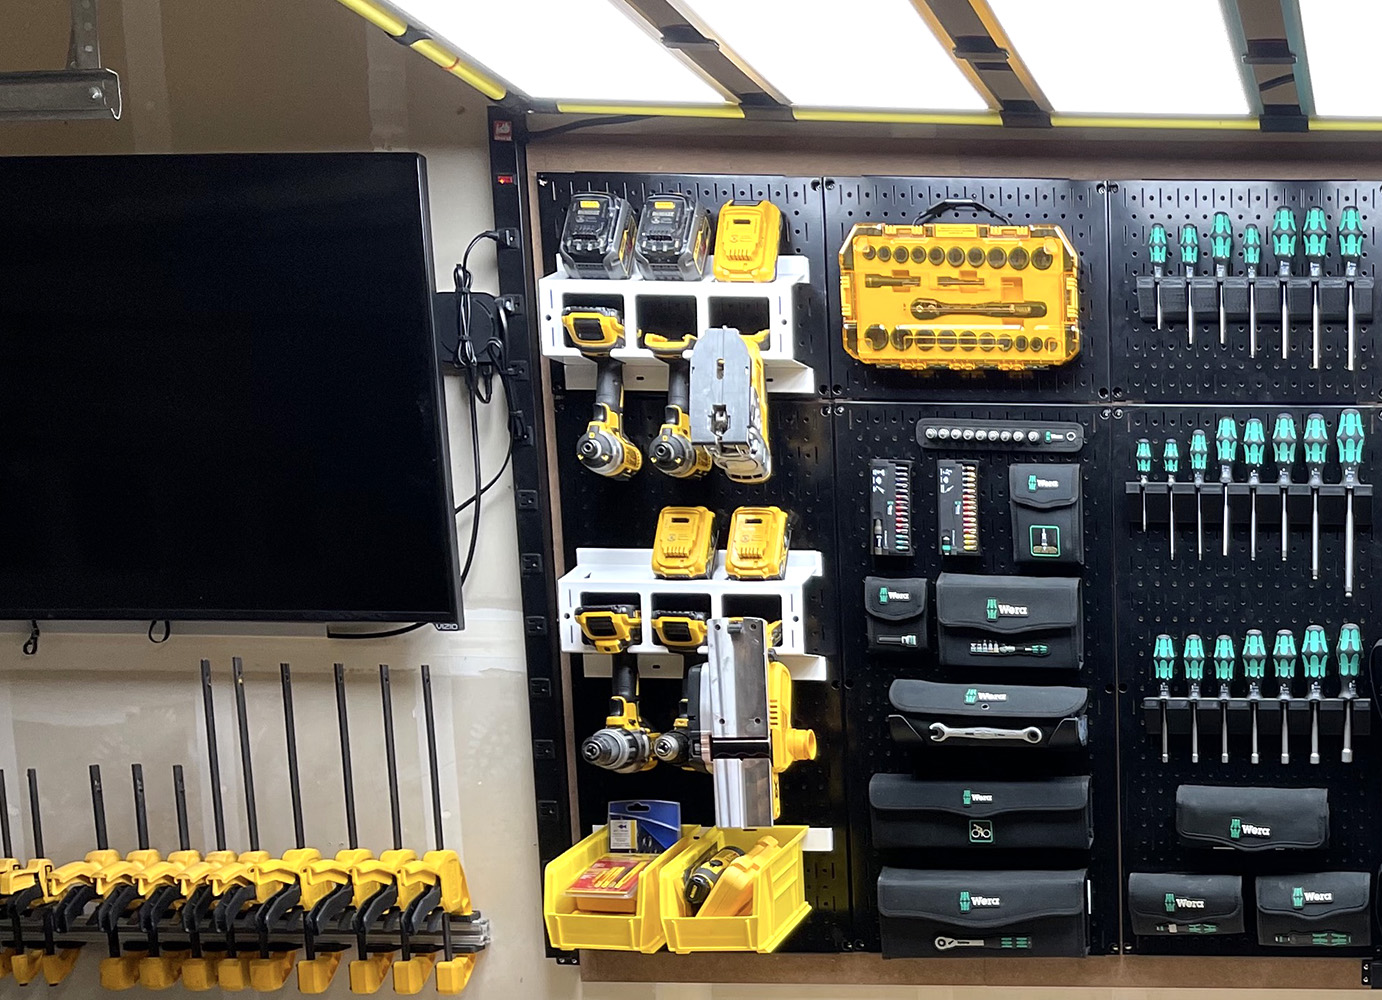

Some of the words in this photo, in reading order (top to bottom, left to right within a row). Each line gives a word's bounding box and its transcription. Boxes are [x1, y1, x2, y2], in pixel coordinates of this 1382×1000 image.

[887, 591, 910, 600] Wera
[998, 604, 1028, 616] Wera
[977, 691, 1007, 702] Wera
[970, 793, 993, 802] Wera
[1241, 824, 1271, 837] Wera
[970, 895, 1001, 907] Wera
[1303, 891, 1333, 902] Wera
[1175, 898, 1205, 909] Wera
